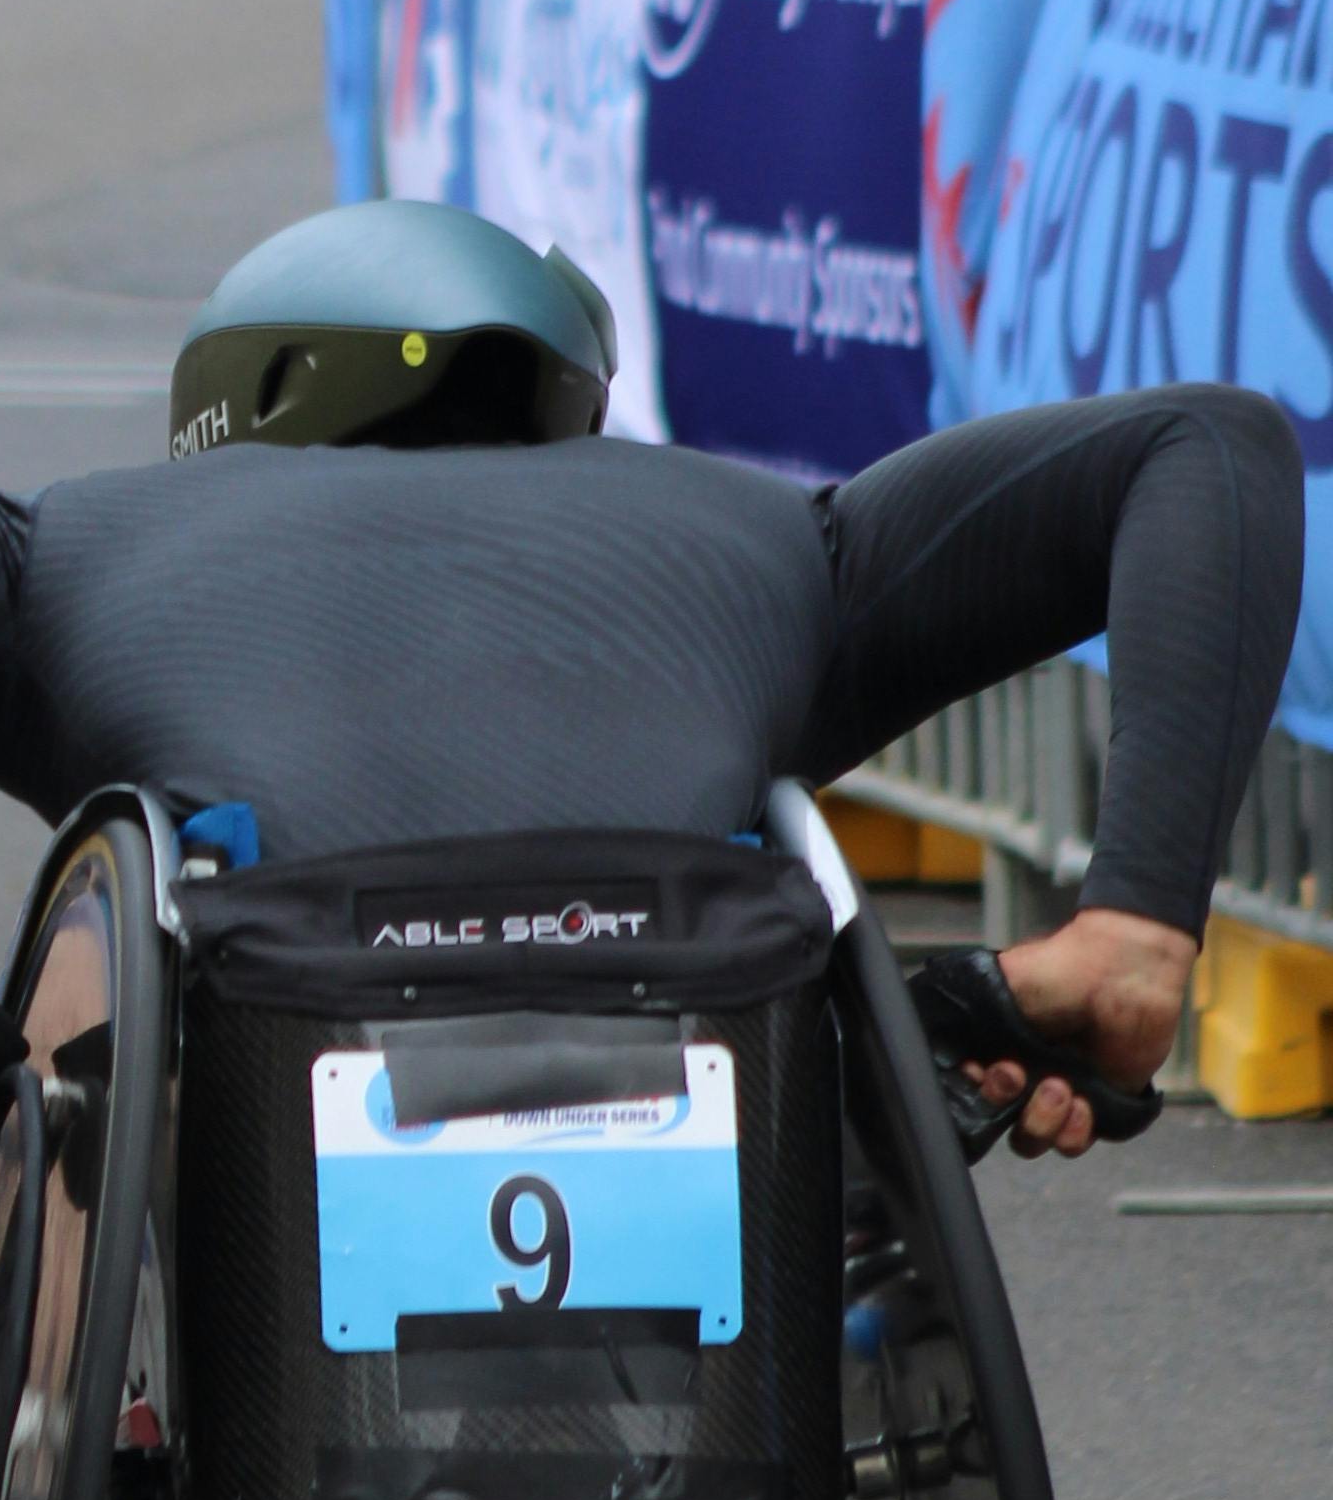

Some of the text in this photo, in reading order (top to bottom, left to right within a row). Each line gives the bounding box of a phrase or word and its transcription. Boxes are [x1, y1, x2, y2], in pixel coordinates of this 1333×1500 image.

[172, 399, 229, 461] SMITH
[371, 900, 650, 948] ABLE SPORT
[503, 1105, 661, 1127] DOWN UNDER SERIES
[488, 1173, 573, 1311] 9
